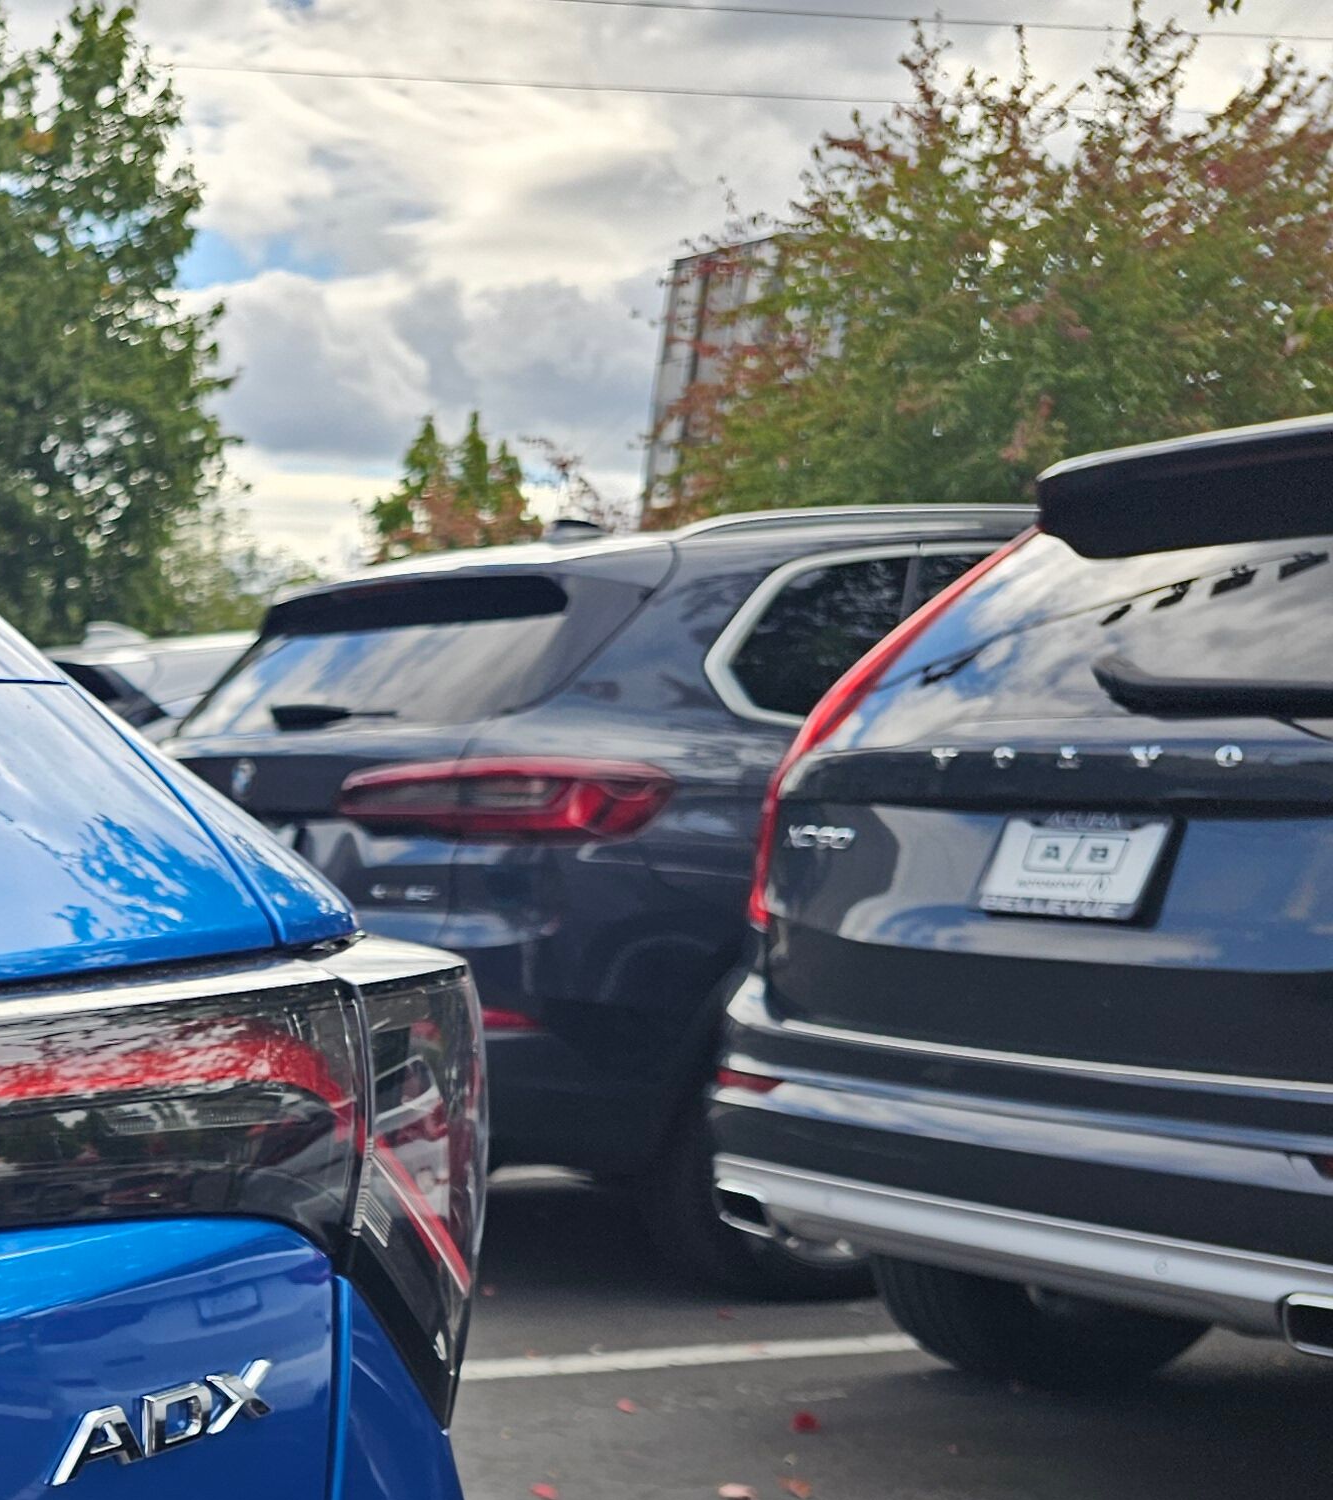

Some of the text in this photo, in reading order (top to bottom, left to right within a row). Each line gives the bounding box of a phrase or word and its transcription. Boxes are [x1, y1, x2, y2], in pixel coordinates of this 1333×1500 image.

[1044, 812, 1122, 828] ACURA
[979, 895, 1120, 918] BELLEVUE
[44, 1358, 274, 1486] ADX
